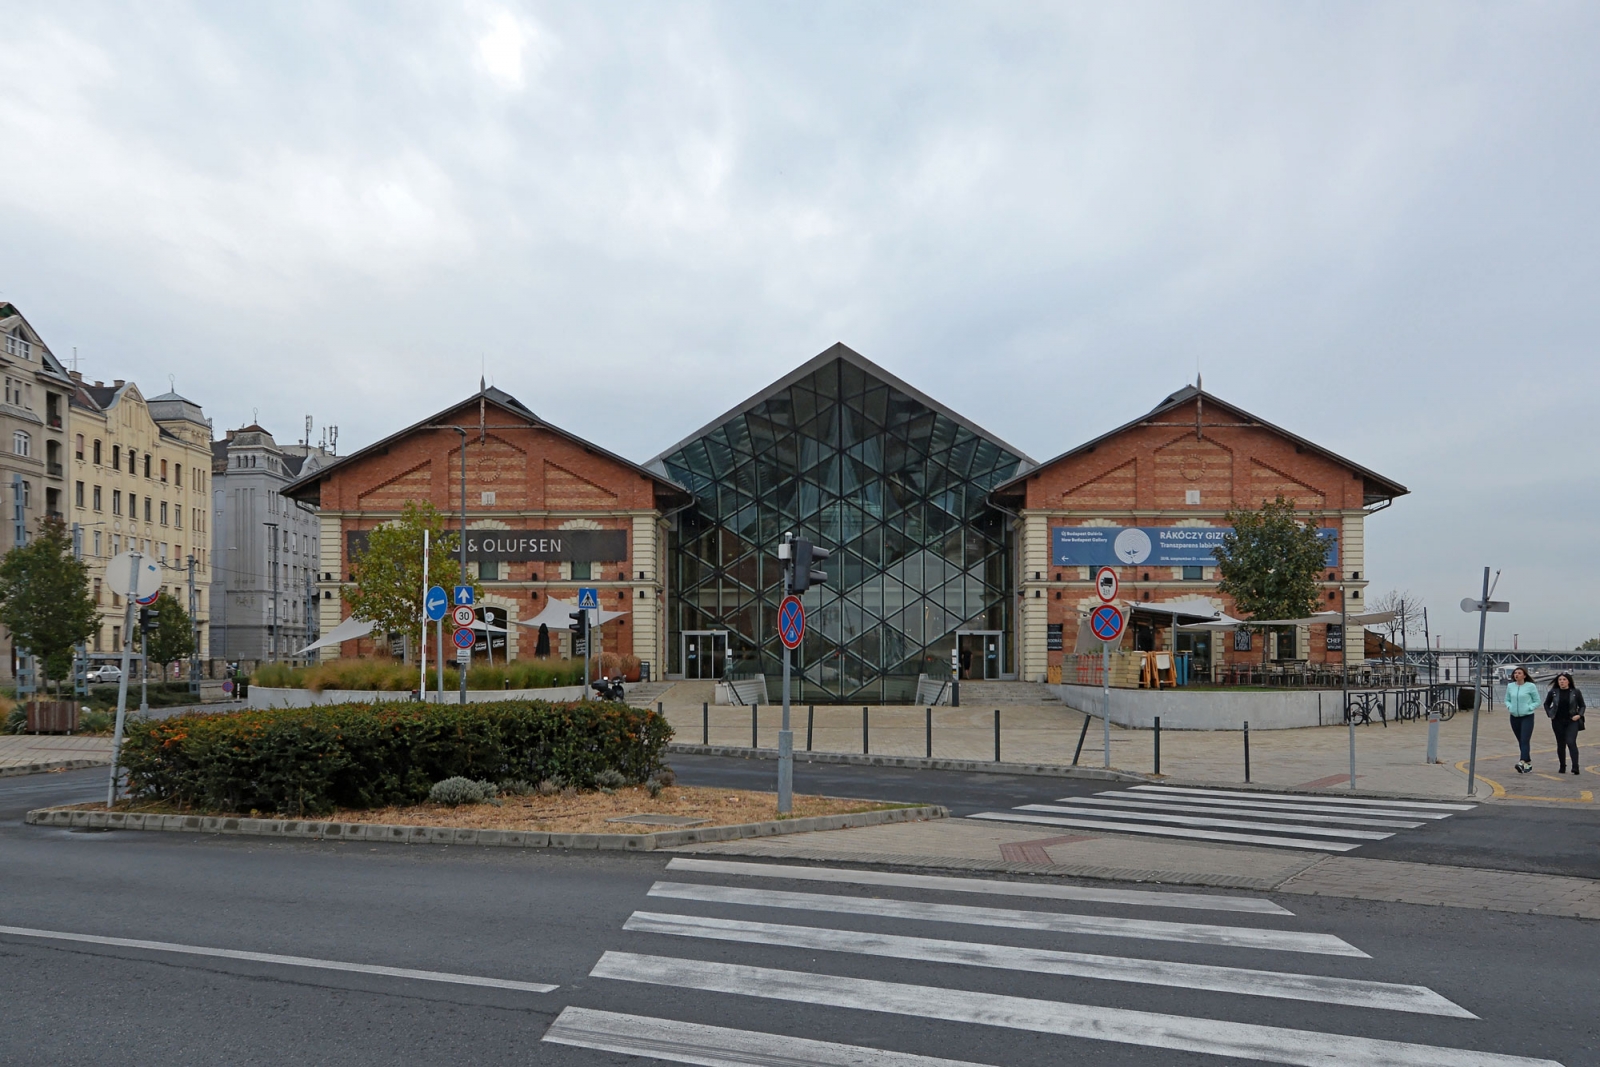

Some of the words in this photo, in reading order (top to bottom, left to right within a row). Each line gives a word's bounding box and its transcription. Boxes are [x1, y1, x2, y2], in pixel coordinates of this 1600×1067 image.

[1160, 530, 1204, 540] RÁKÓCZY
[467, 539, 478, 552] &
[483, 539, 561, 552] OLUFSEN
[458, 612, 470, 620] 30
